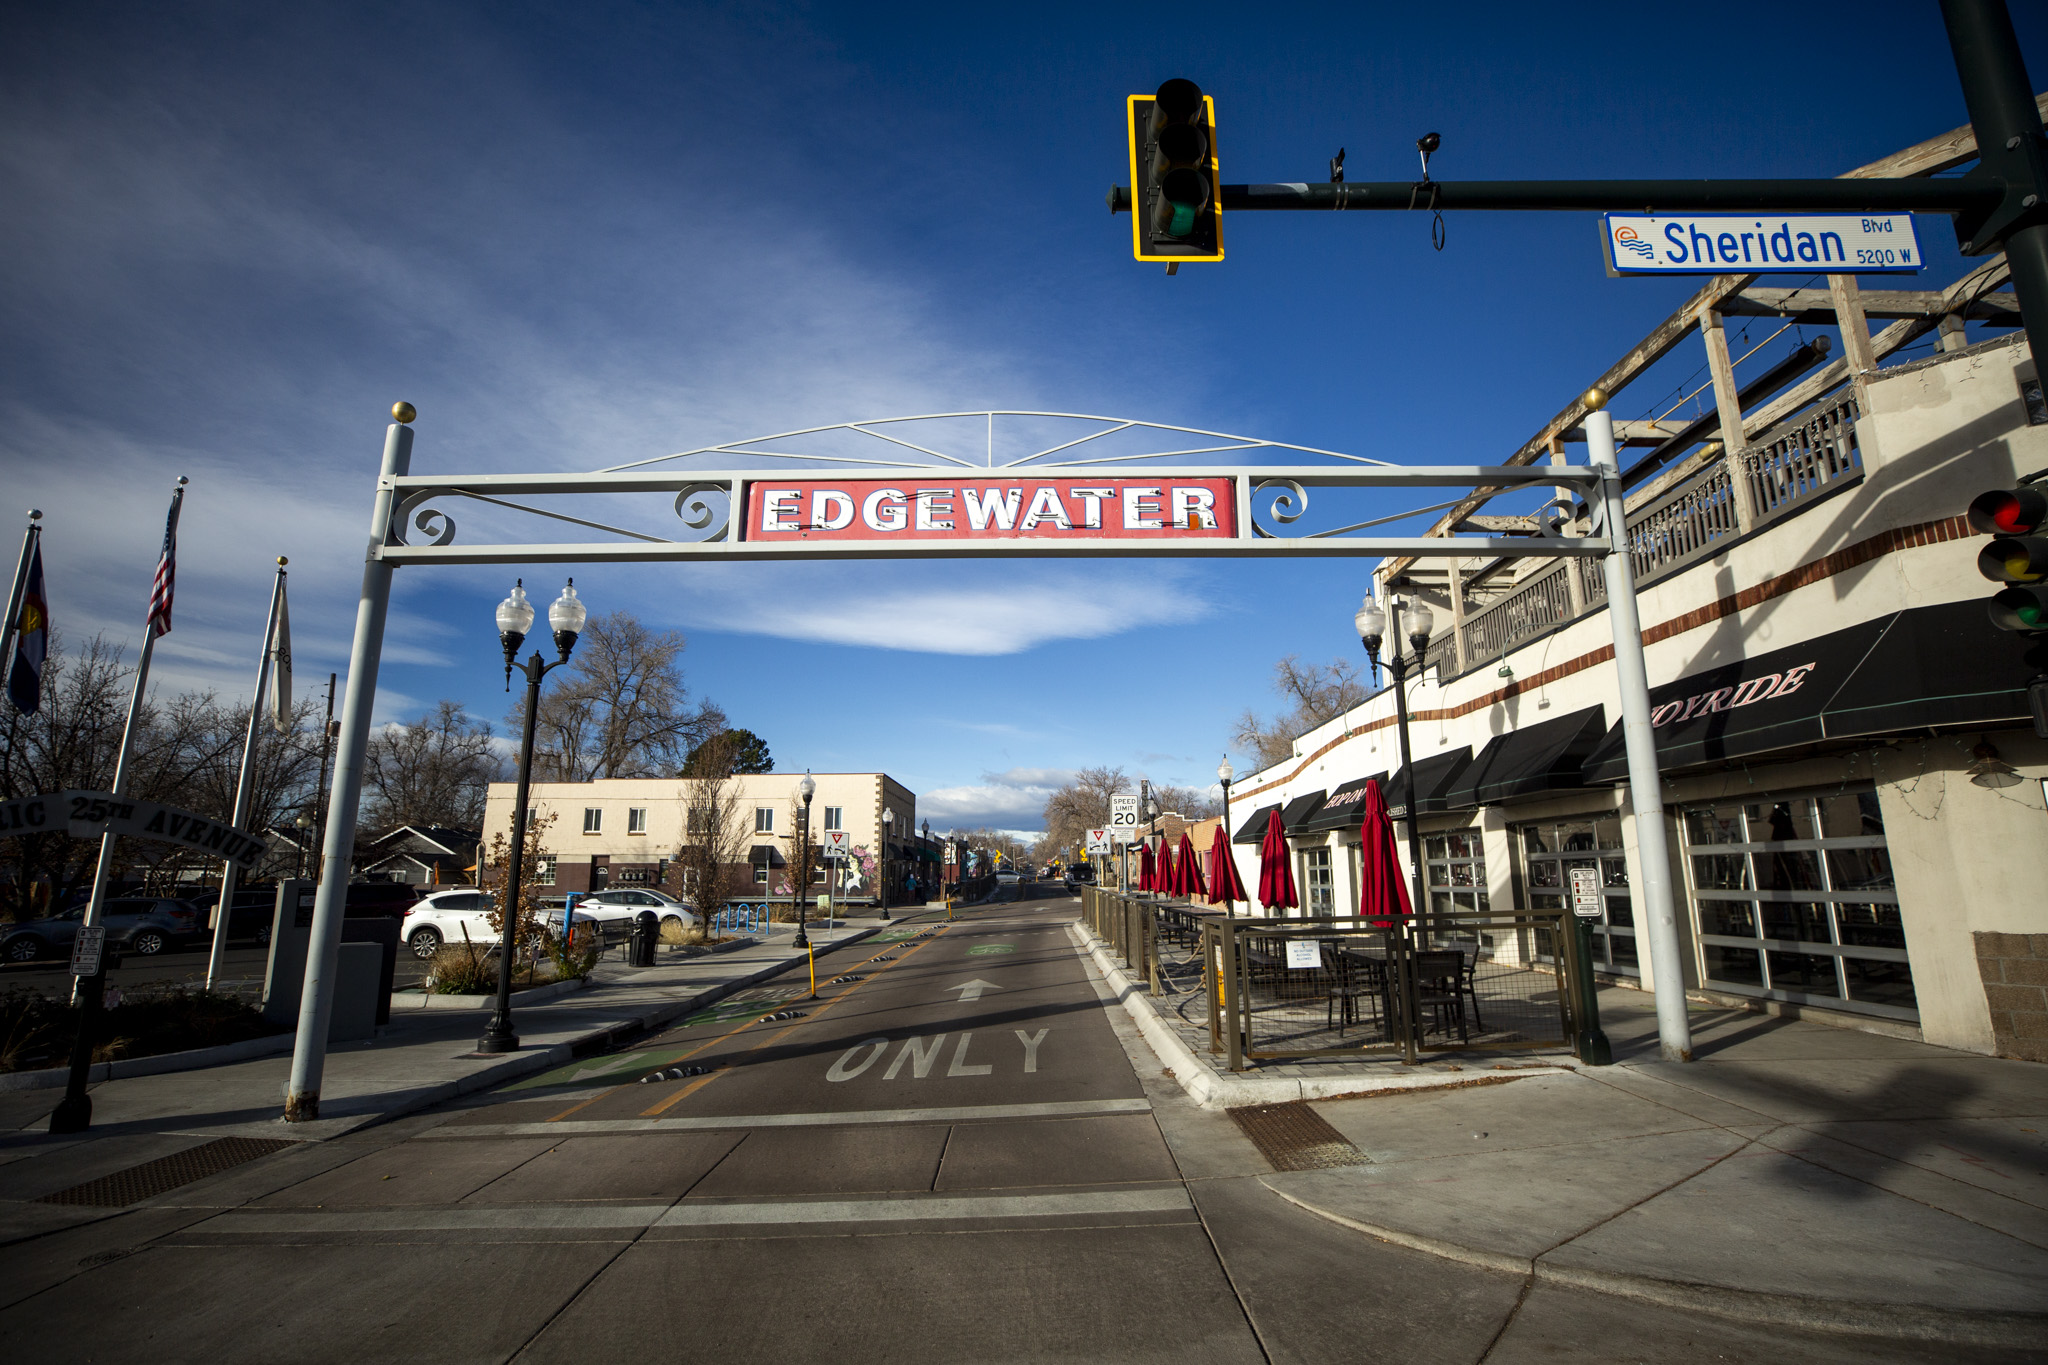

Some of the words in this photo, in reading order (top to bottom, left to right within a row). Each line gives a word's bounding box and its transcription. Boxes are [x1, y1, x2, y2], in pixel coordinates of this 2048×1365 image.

[1664, 222, 1846, 263] Sheridan
[1861, 218, 1893, 233] Blvd
[1857, 249, 1895, 264] 5200
[1899, 248, 1911, 263] W
[761, 486, 1219, 532] EDGEWATER
[69, 796, 135, 823] 25TH
[144, 809, 267, 865] AVENUE
[1114, 812, 1135, 825] 20
[826, 1028, 1050, 1082] ONLY
